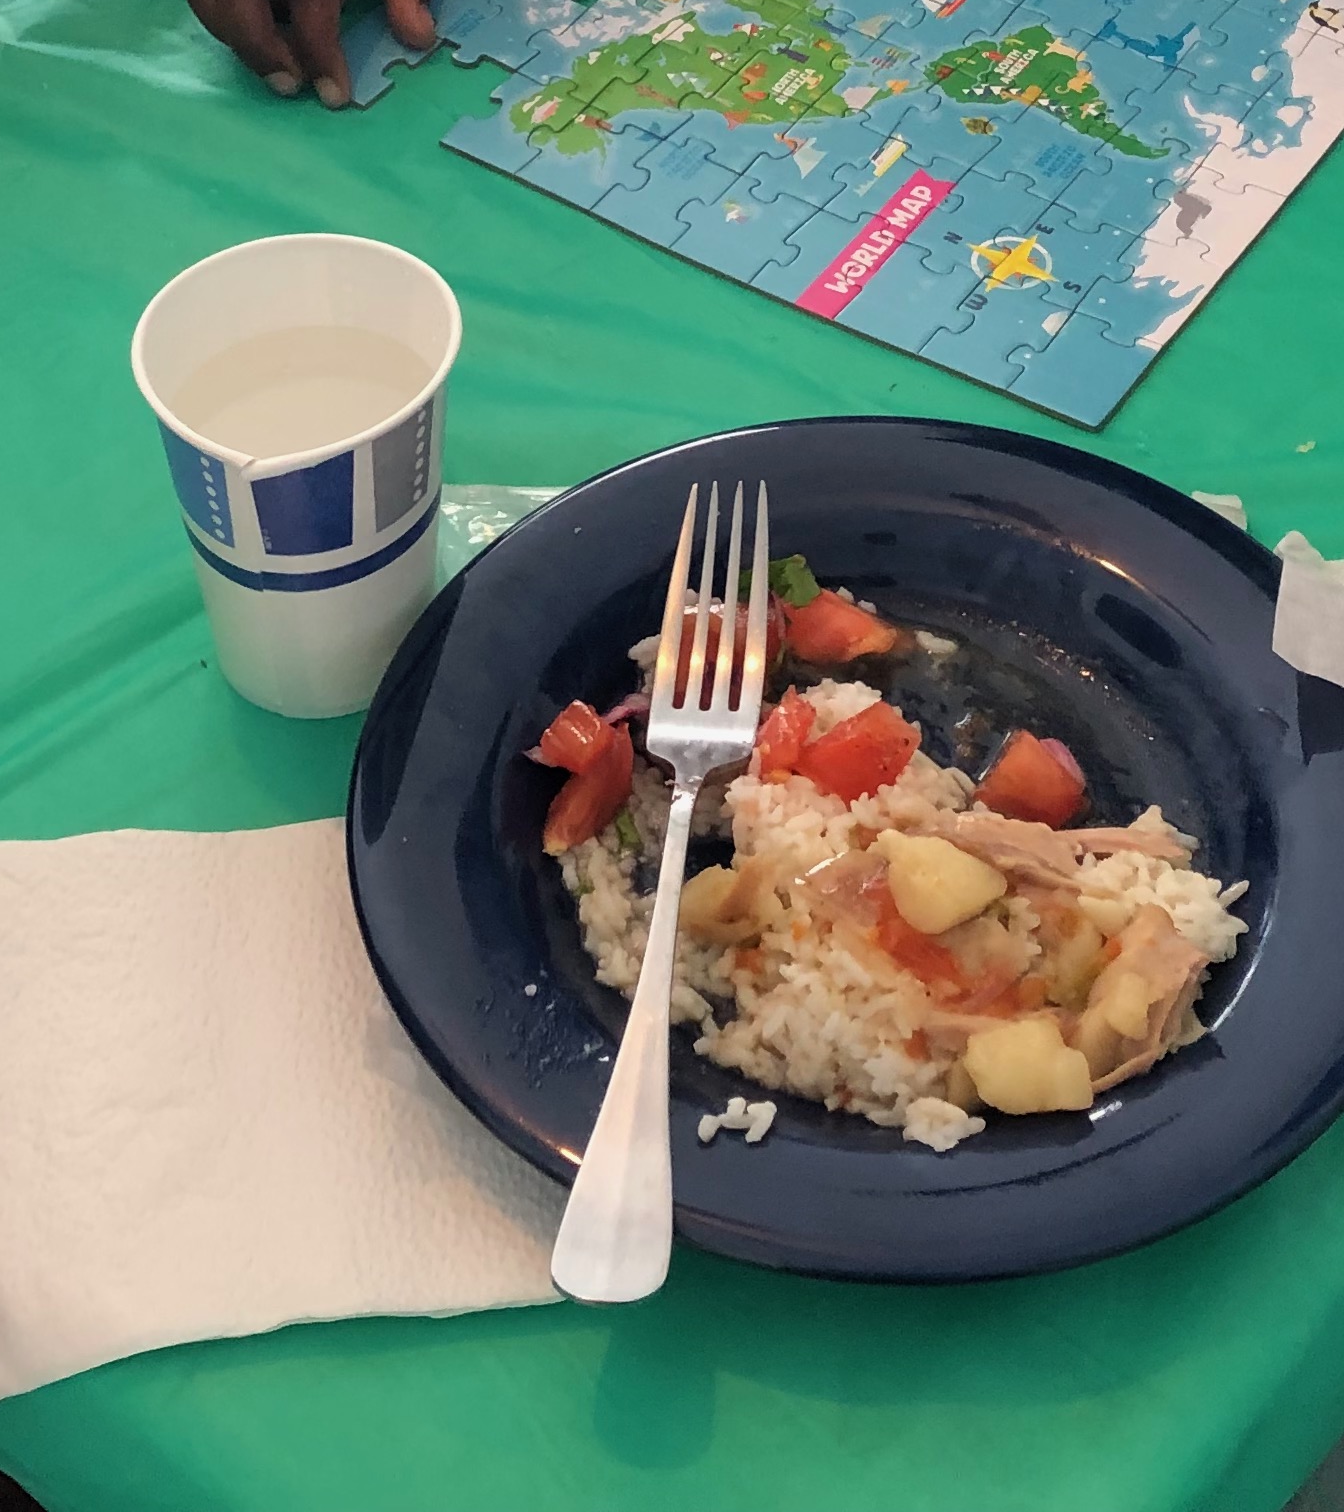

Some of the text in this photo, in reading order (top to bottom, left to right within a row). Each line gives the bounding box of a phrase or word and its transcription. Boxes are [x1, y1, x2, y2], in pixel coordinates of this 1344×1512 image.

[994, 49, 1023, 74] SOUTH
[1000, 49, 1039, 84] AMERICA
[775, 69, 816, 105] AMERICA
[823, 185, 932, 294] WORLD MAP
[943, 231, 963, 245] N
[1035, 223, 1055, 235] E
[1063, 280, 1082, 294] S
[965, 293, 988, 311] W
